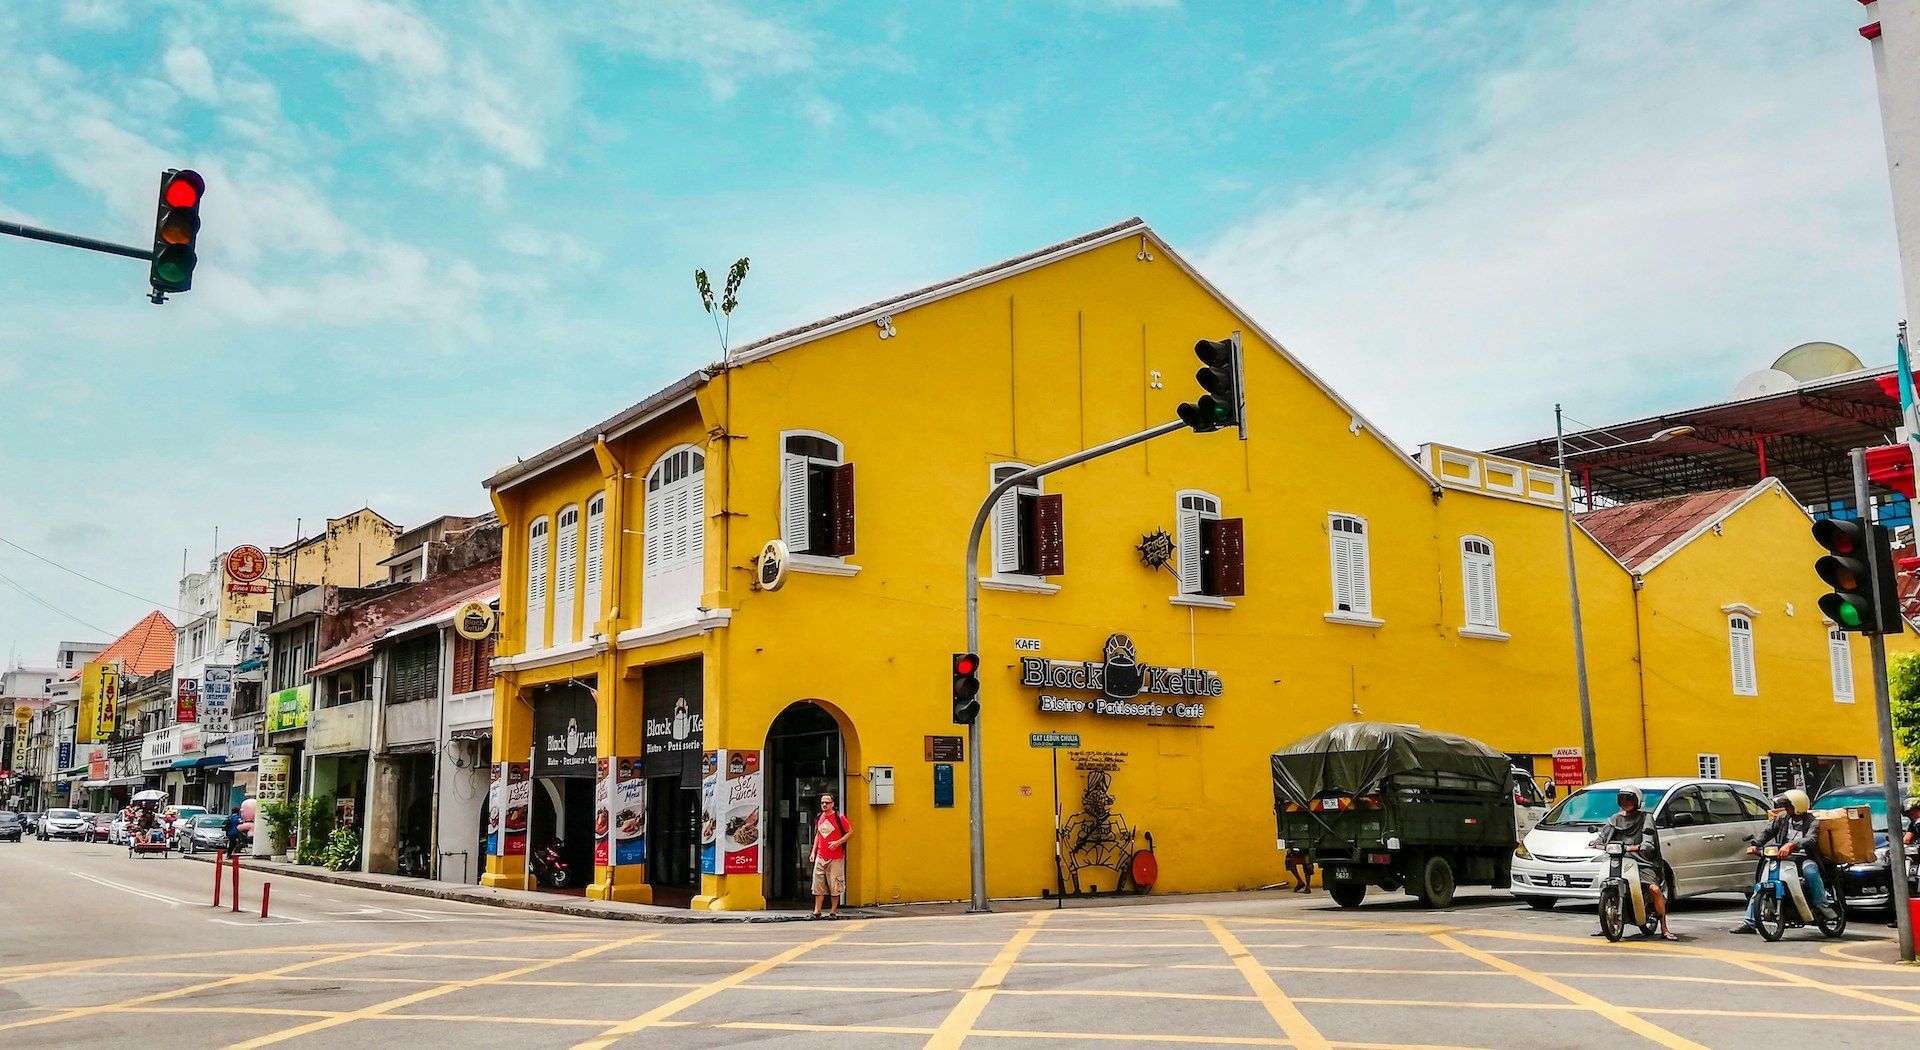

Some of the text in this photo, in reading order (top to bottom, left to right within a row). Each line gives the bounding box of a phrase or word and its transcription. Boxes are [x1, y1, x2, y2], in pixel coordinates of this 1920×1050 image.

[1015, 639, 1040, 650] KAFE
[180, 680, 197, 691] 4D
[1021, 656, 1224, 697] Black Kettle
[1040, 695, 1205, 719] Bistro Patisserie Café
[646, 717, 672, 738] Black
[547, 731, 597, 751] Black Kettl
[735, 775, 752, 791] Set
[729, 783, 758, 805] Lunch
